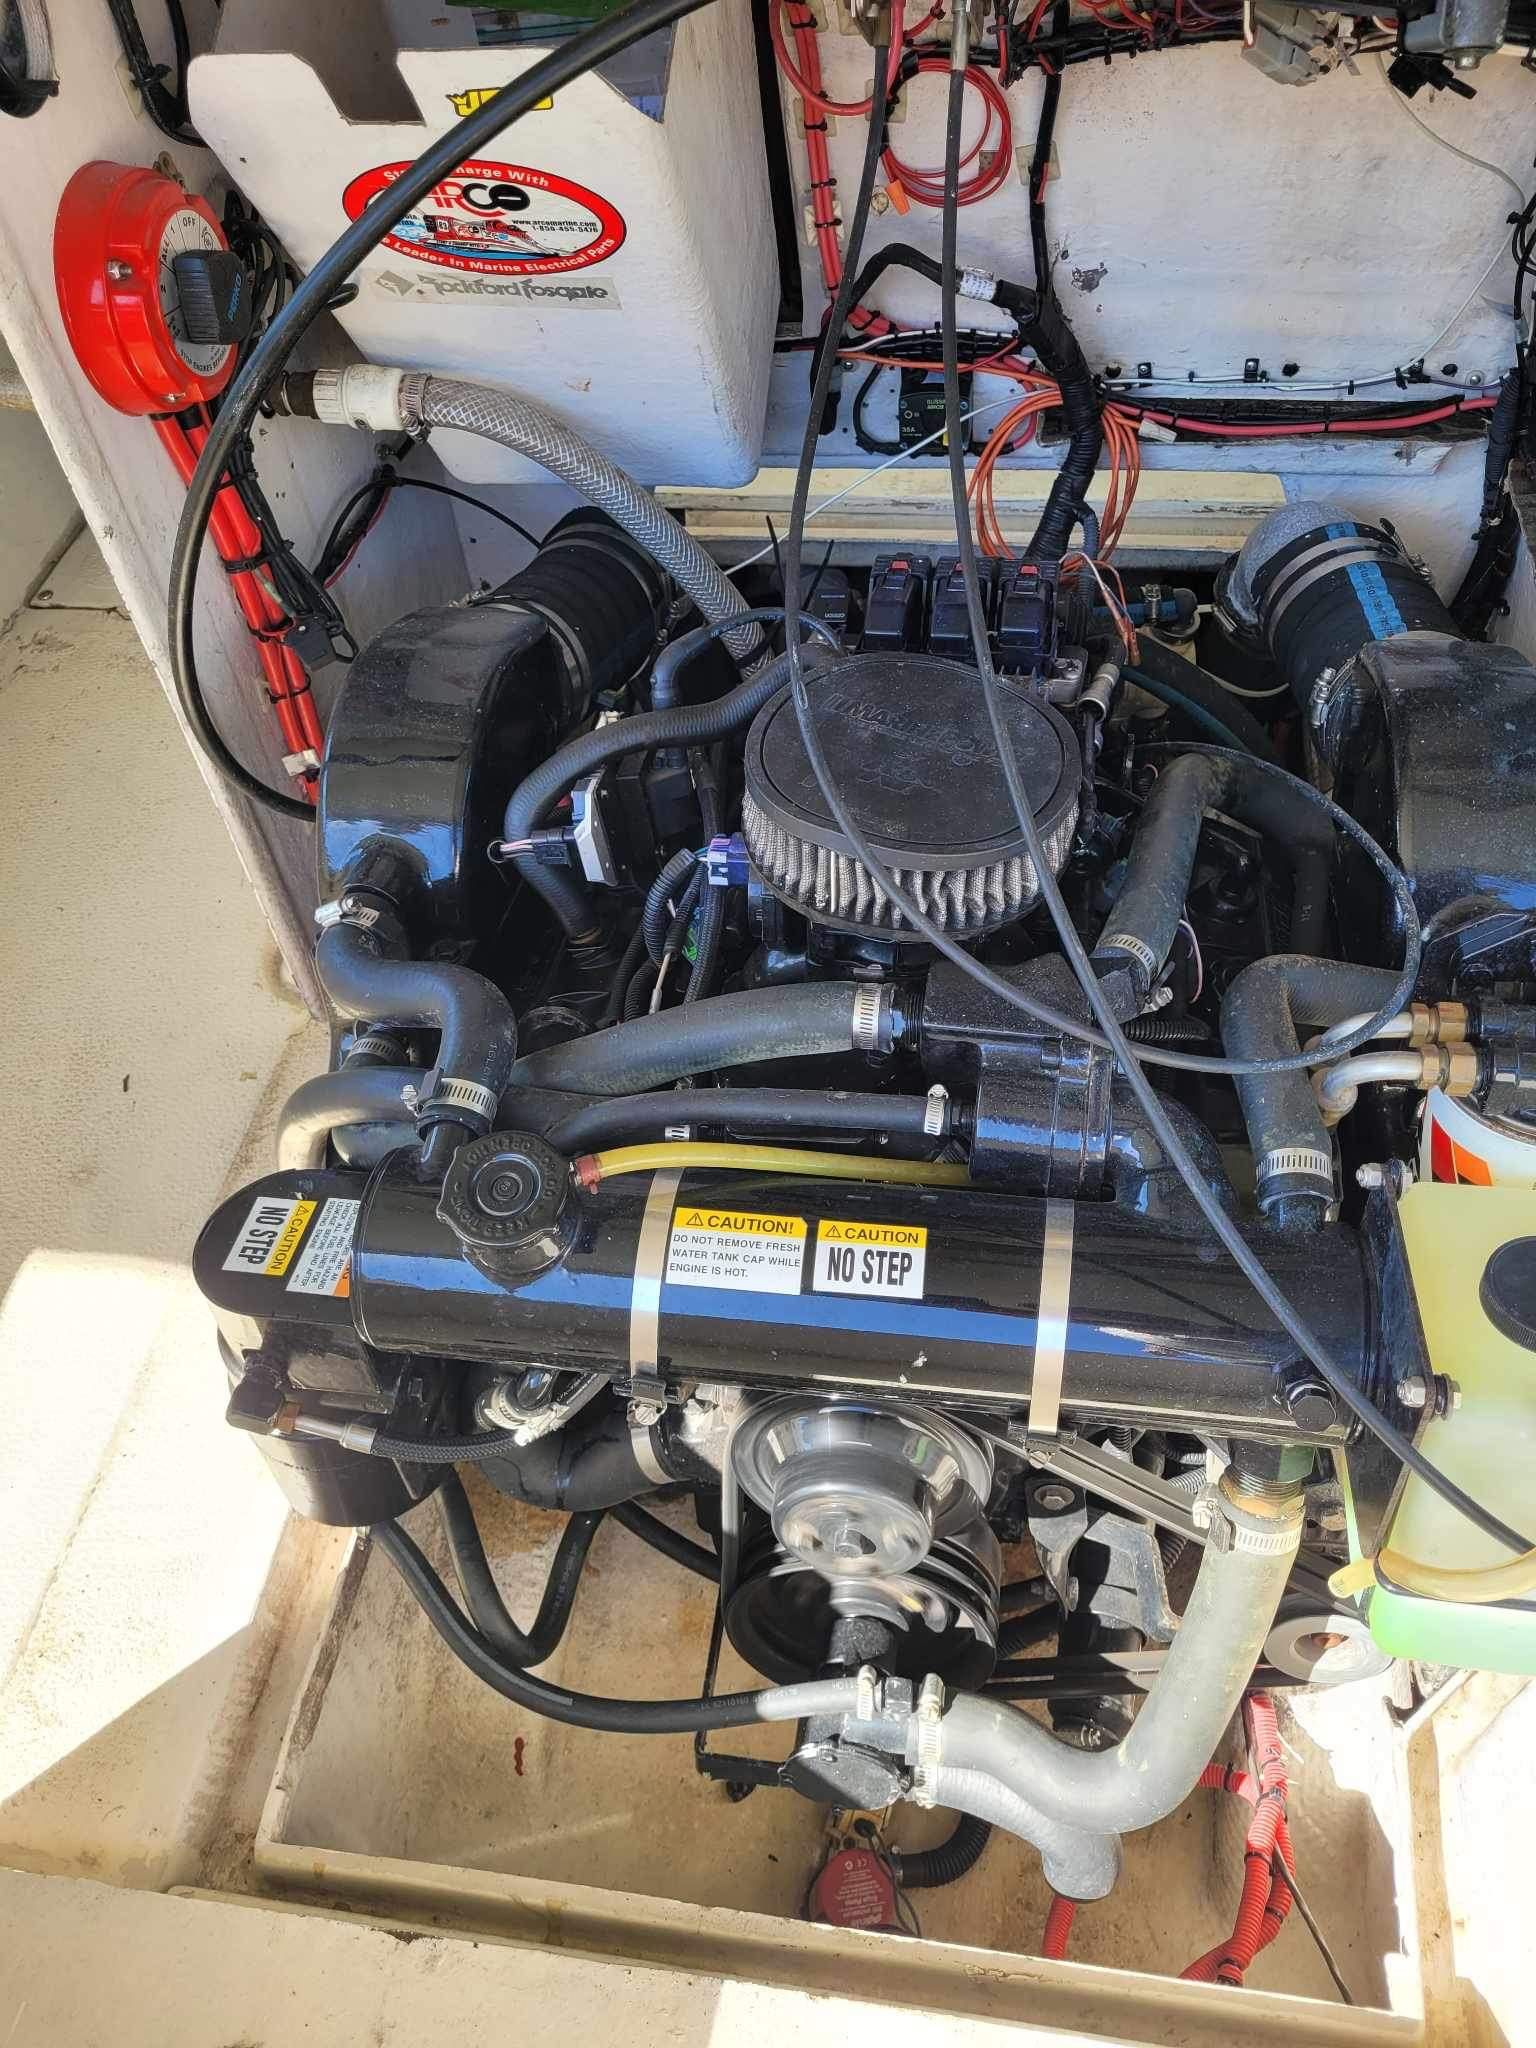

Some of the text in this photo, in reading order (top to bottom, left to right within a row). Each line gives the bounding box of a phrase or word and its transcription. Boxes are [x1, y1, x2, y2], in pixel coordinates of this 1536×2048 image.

[454, 164, 549, 187] harge With
[182, 216, 196, 227] OFF
[394, 242, 444, 263] Leader
[469, 261, 521, 272] Marine
[525, 254, 588, 272] Electrical
[590, 238, 615, 258] Parts
[707, 1215, 793, 1234] CAUTION!
[239, 1206, 290, 1264] NO STEP
[271, 1218, 303, 1270] CAUTION
[673, 1234, 800, 1252] DO NOT REMOVE FRESH
[845, 1228, 919, 1244] CAUTION
[672, 1249, 800, 1267] WATER TANK CAP WHILE
[827, 1247, 913, 1286] NO STEP
[669, 1263, 749, 1278] ENGINE IS HOT.
